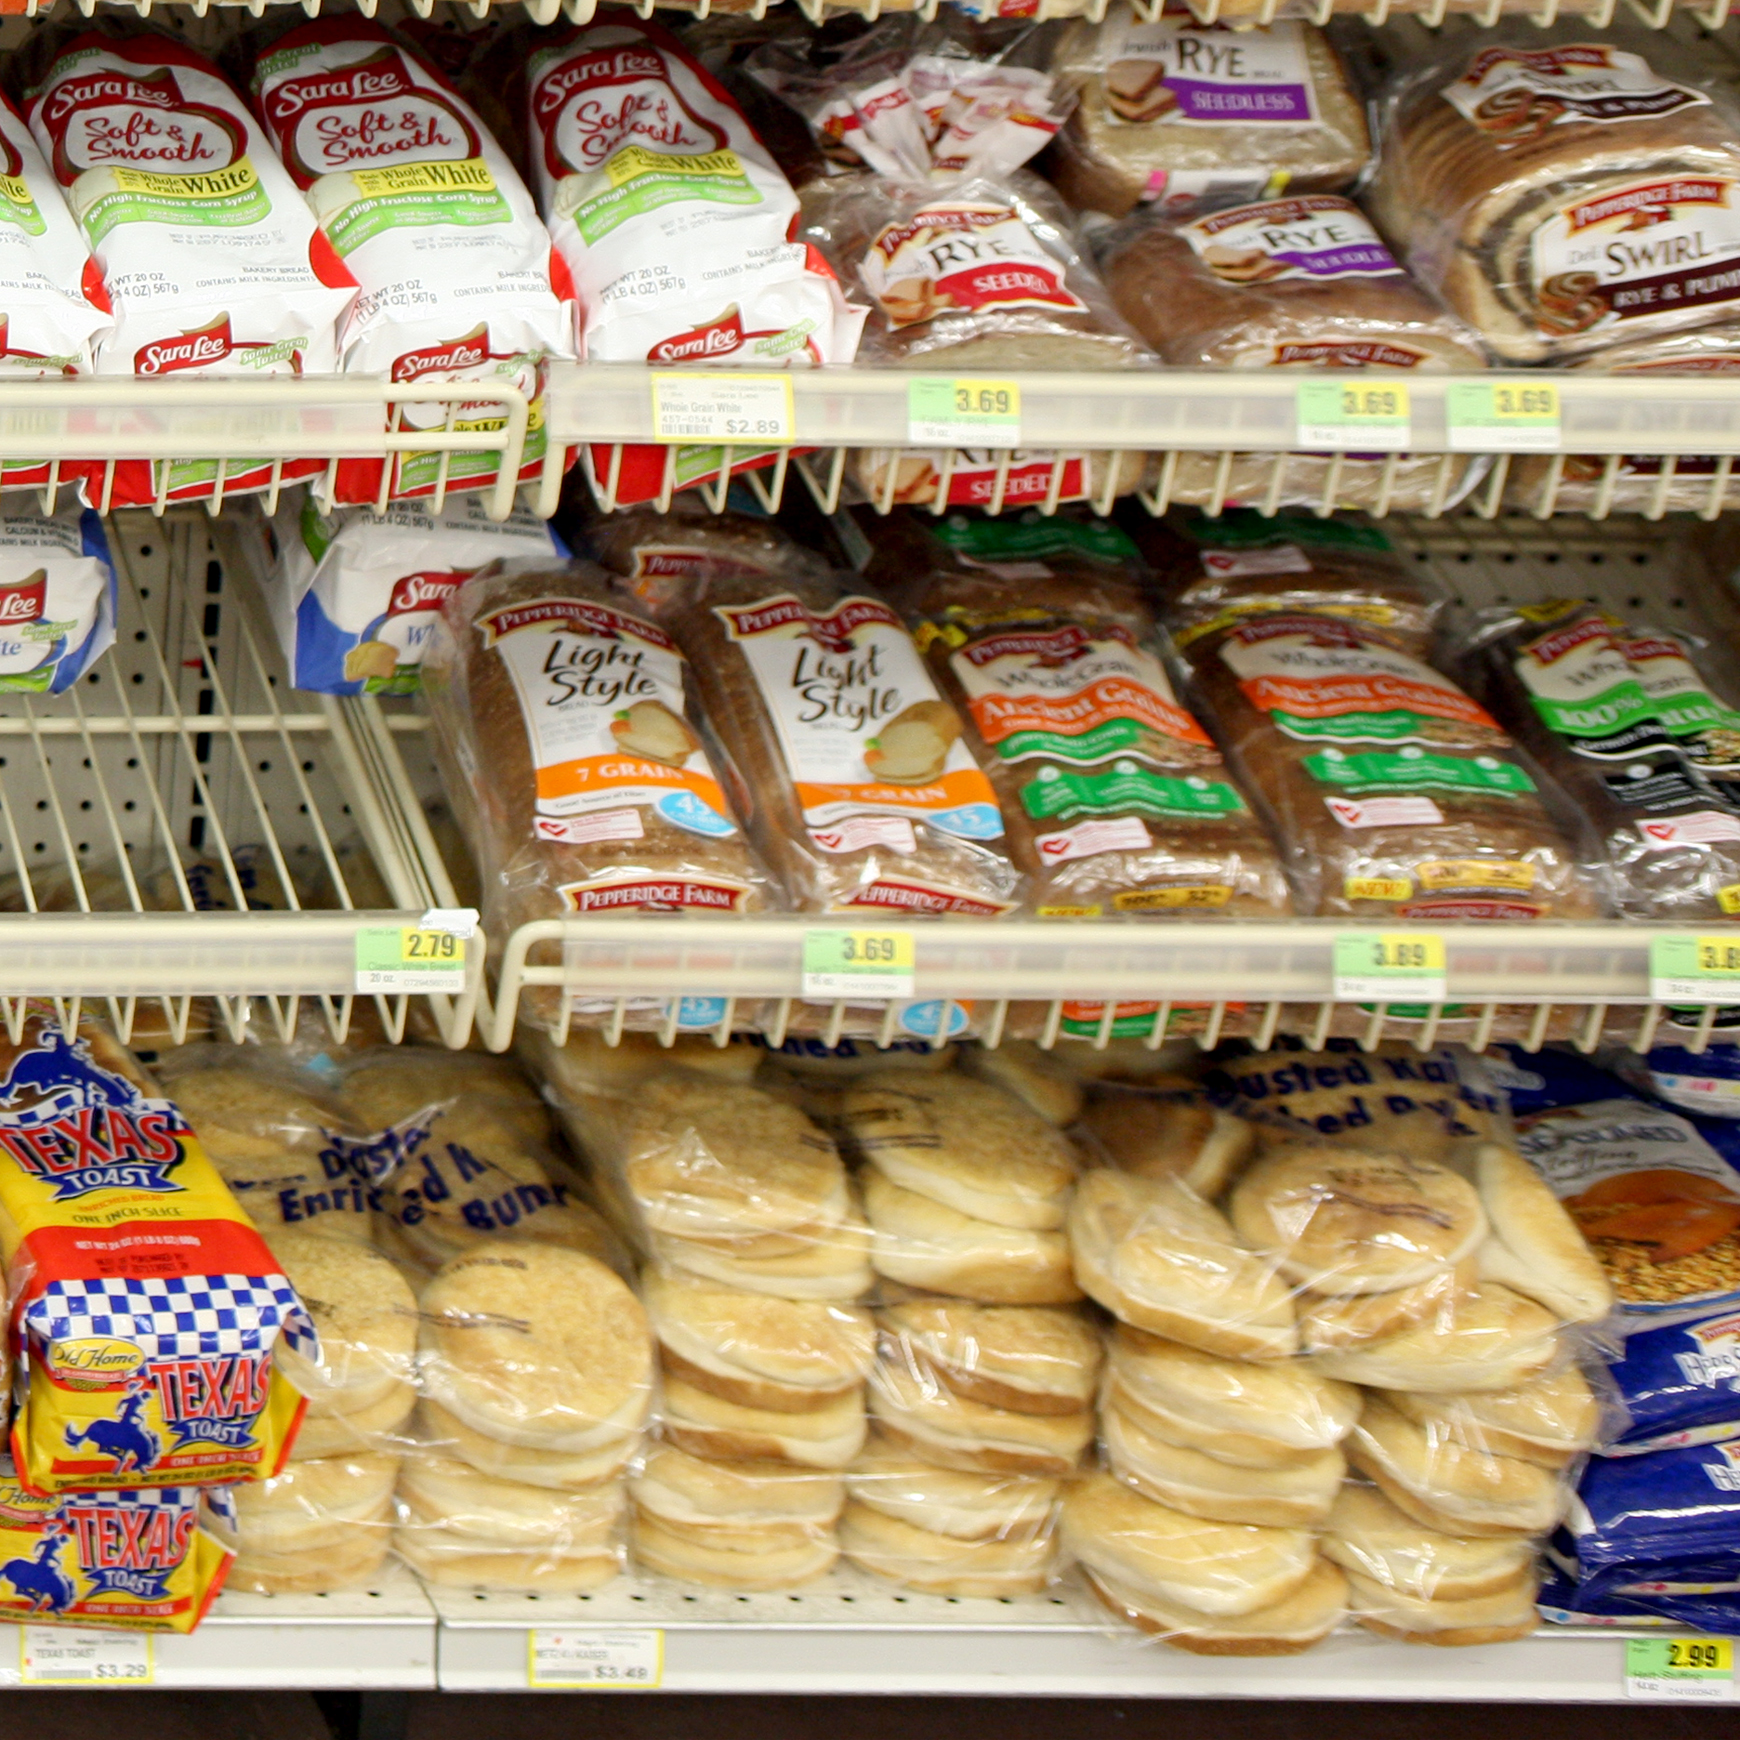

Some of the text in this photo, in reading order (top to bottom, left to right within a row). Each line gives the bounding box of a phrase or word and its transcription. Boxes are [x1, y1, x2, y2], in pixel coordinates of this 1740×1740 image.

[1176, 37, 1247, 79] RYE
[1191, 90, 1294, 112] SEEDLESS
[930, 239, 1015, 274] RYE
[1605, 231, 1709, 277] SWIRL
[661, 402, 742, 414] Whole Grain White
[956, 388, 1009, 414] 3.69
[726, 420, 780, 434] $2.89
[543, 639, 645, 675] Light
[546, 668, 656, 706] Style
[580, 885, 730, 911] PEPPERIDGE FARM
[408, 934, 455, 958] 2.79
[843, 937, 894, 961] 3.69
[63, 1167, 151, 1189] TOAST
[36, 1648, 64, 1659] TEXAS
[1668, 1644, 1719, 1668] 2.99
[96, 1666, 147, 1680] $3.29
